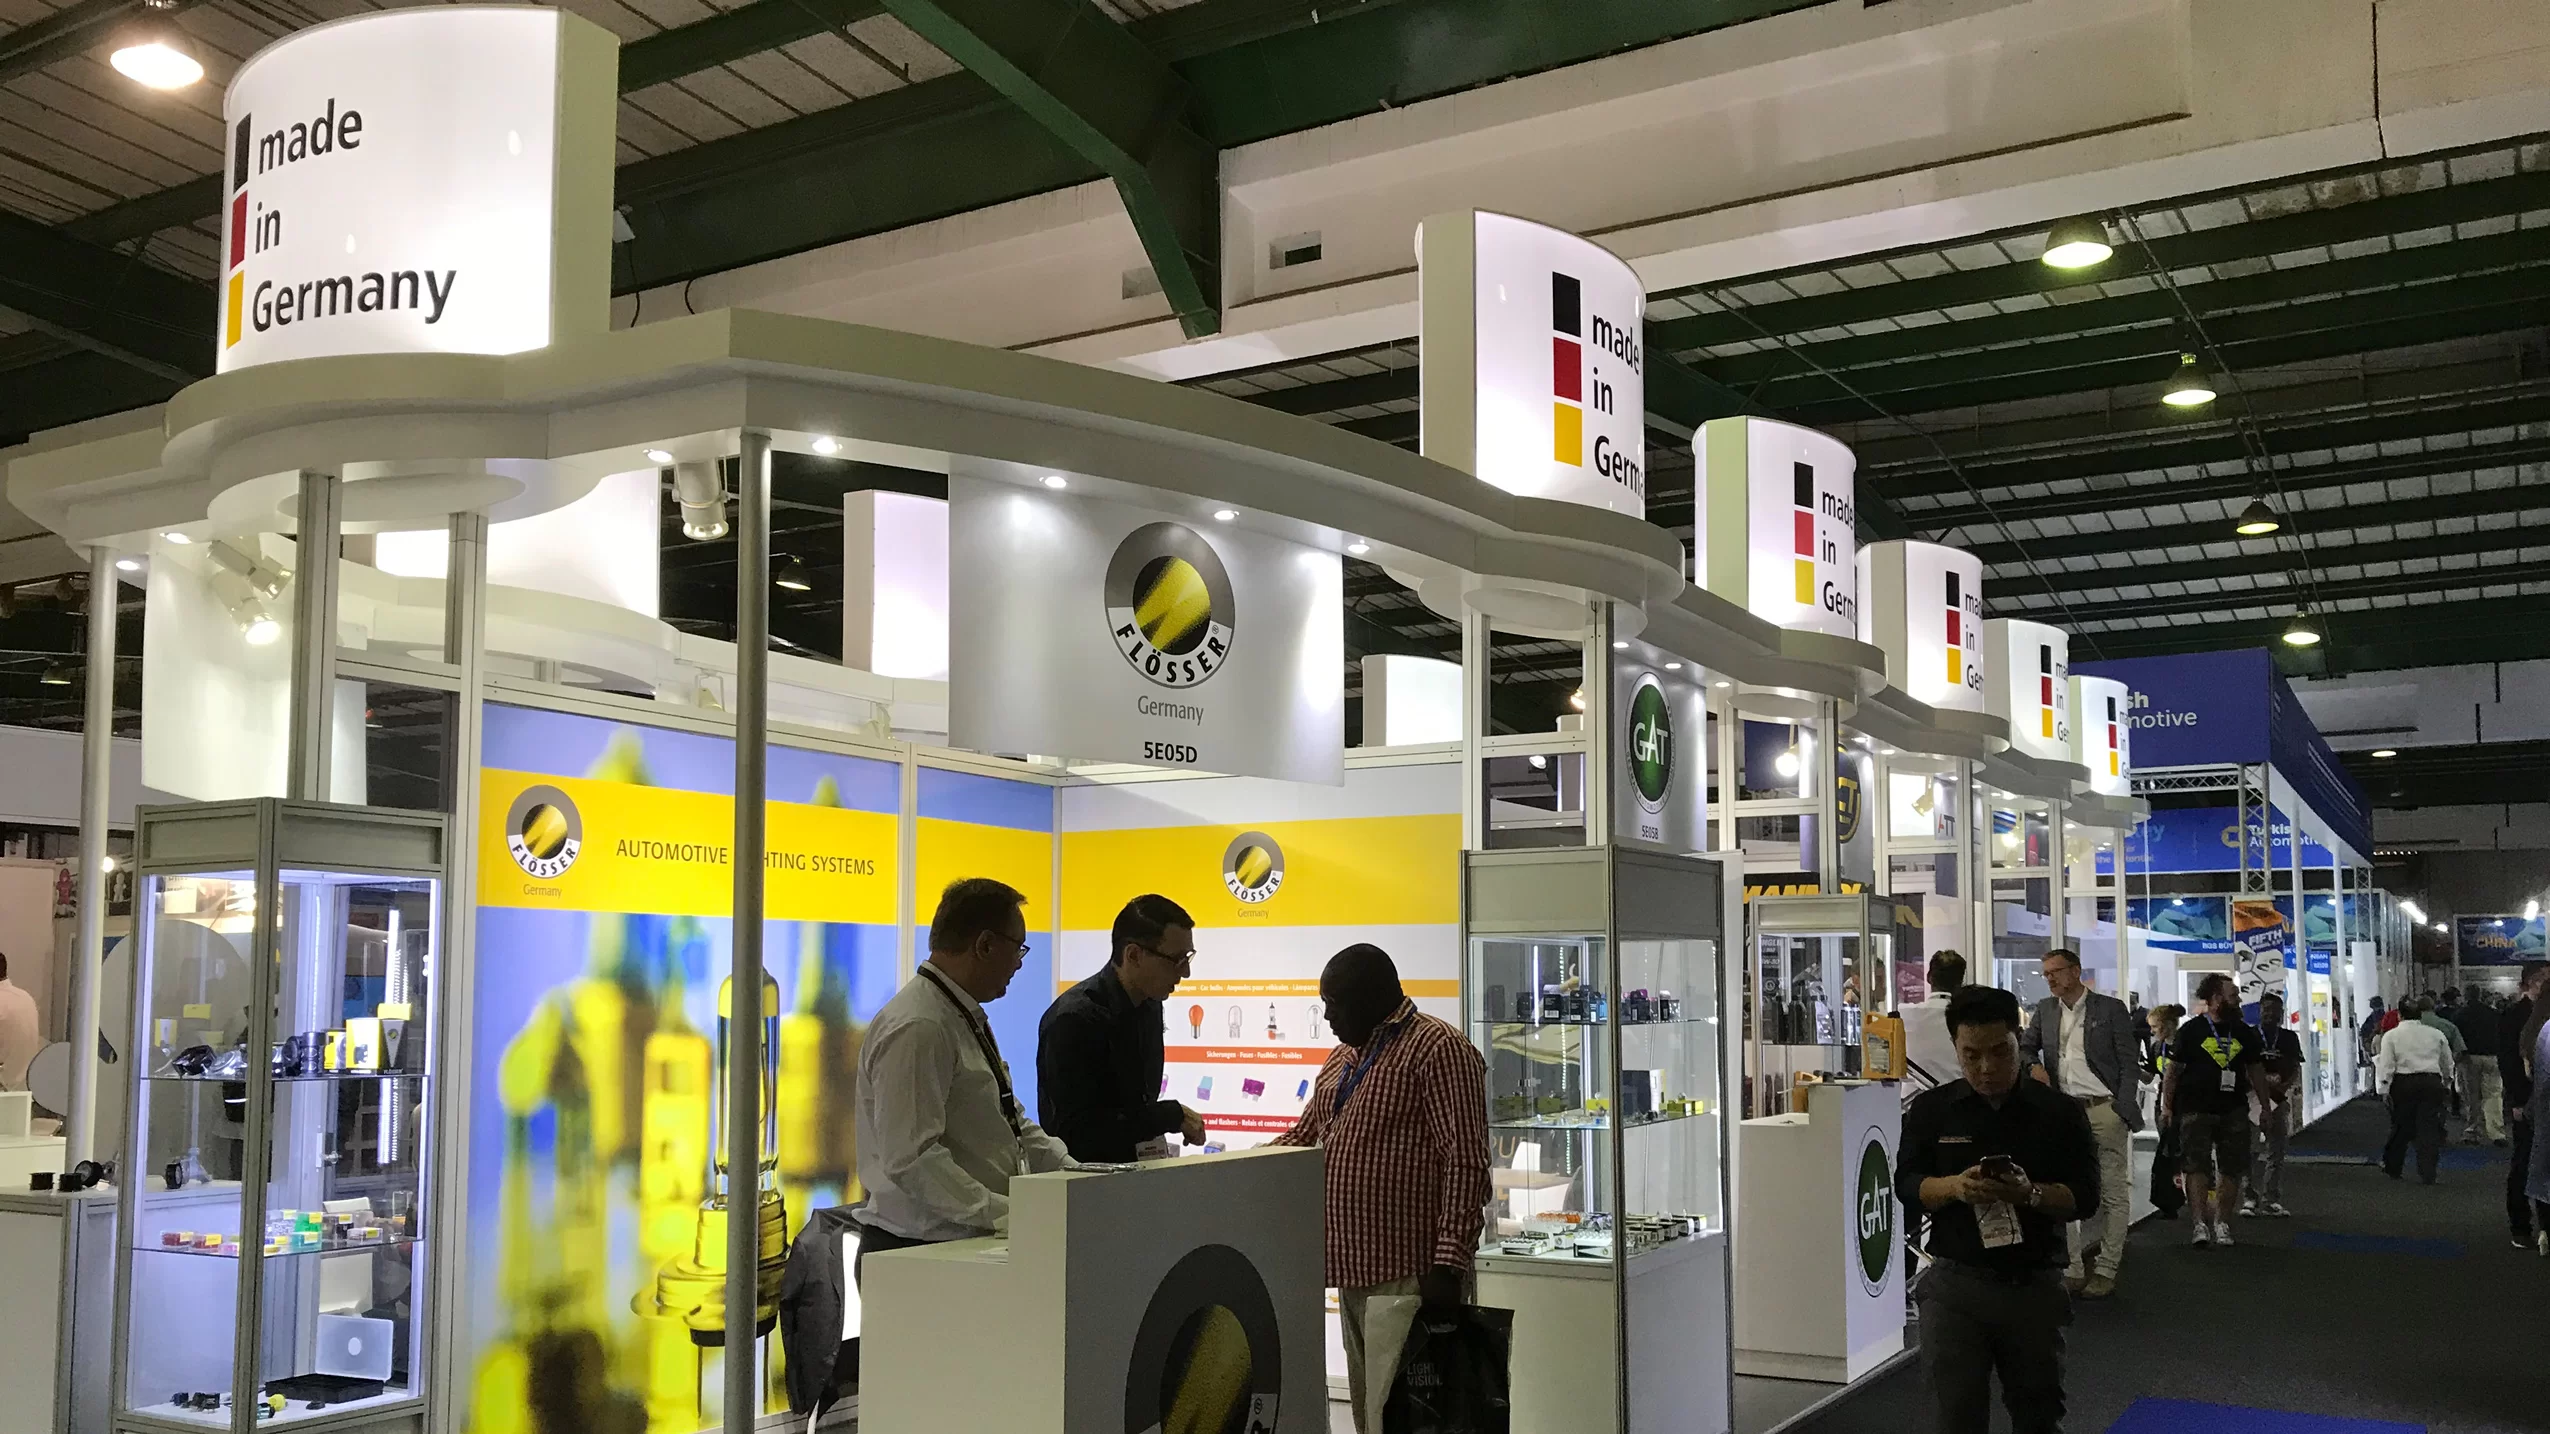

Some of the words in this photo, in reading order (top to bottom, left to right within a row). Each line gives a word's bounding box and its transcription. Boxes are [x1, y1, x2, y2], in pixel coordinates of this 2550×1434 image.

[258, 98, 362, 175] made
[255, 201, 281, 254] in
[252, 269, 457, 332] Germany
[1592, 314, 1640, 376] made
[1593, 366, 1613, 416] in
[1822, 530, 1836, 565] in
[1116, 623, 1226, 683] FLÖSSER
[1966, 624, 1975, 652] in
[1137, 695, 1204, 726] Germany
[2128, 691, 2149, 709] sh
[2127, 709, 2197, 729] motive
[1144, 741, 1198, 763] 5E05D
[1633, 714, 1669, 766] GAT
[512, 843, 576, 876] FLÖSSER
[616, 839, 728, 865] AUTOMOTIVE
[764, 851, 806, 871] HTING
[811, 855, 875, 876] SYSTEMS
[523, 883, 562, 898] Germany
[1228, 876, 1280, 902] FLÖSSER
[1237, 908, 1269, 919] Germany
[1860, 1173, 1890, 1240] GAT
